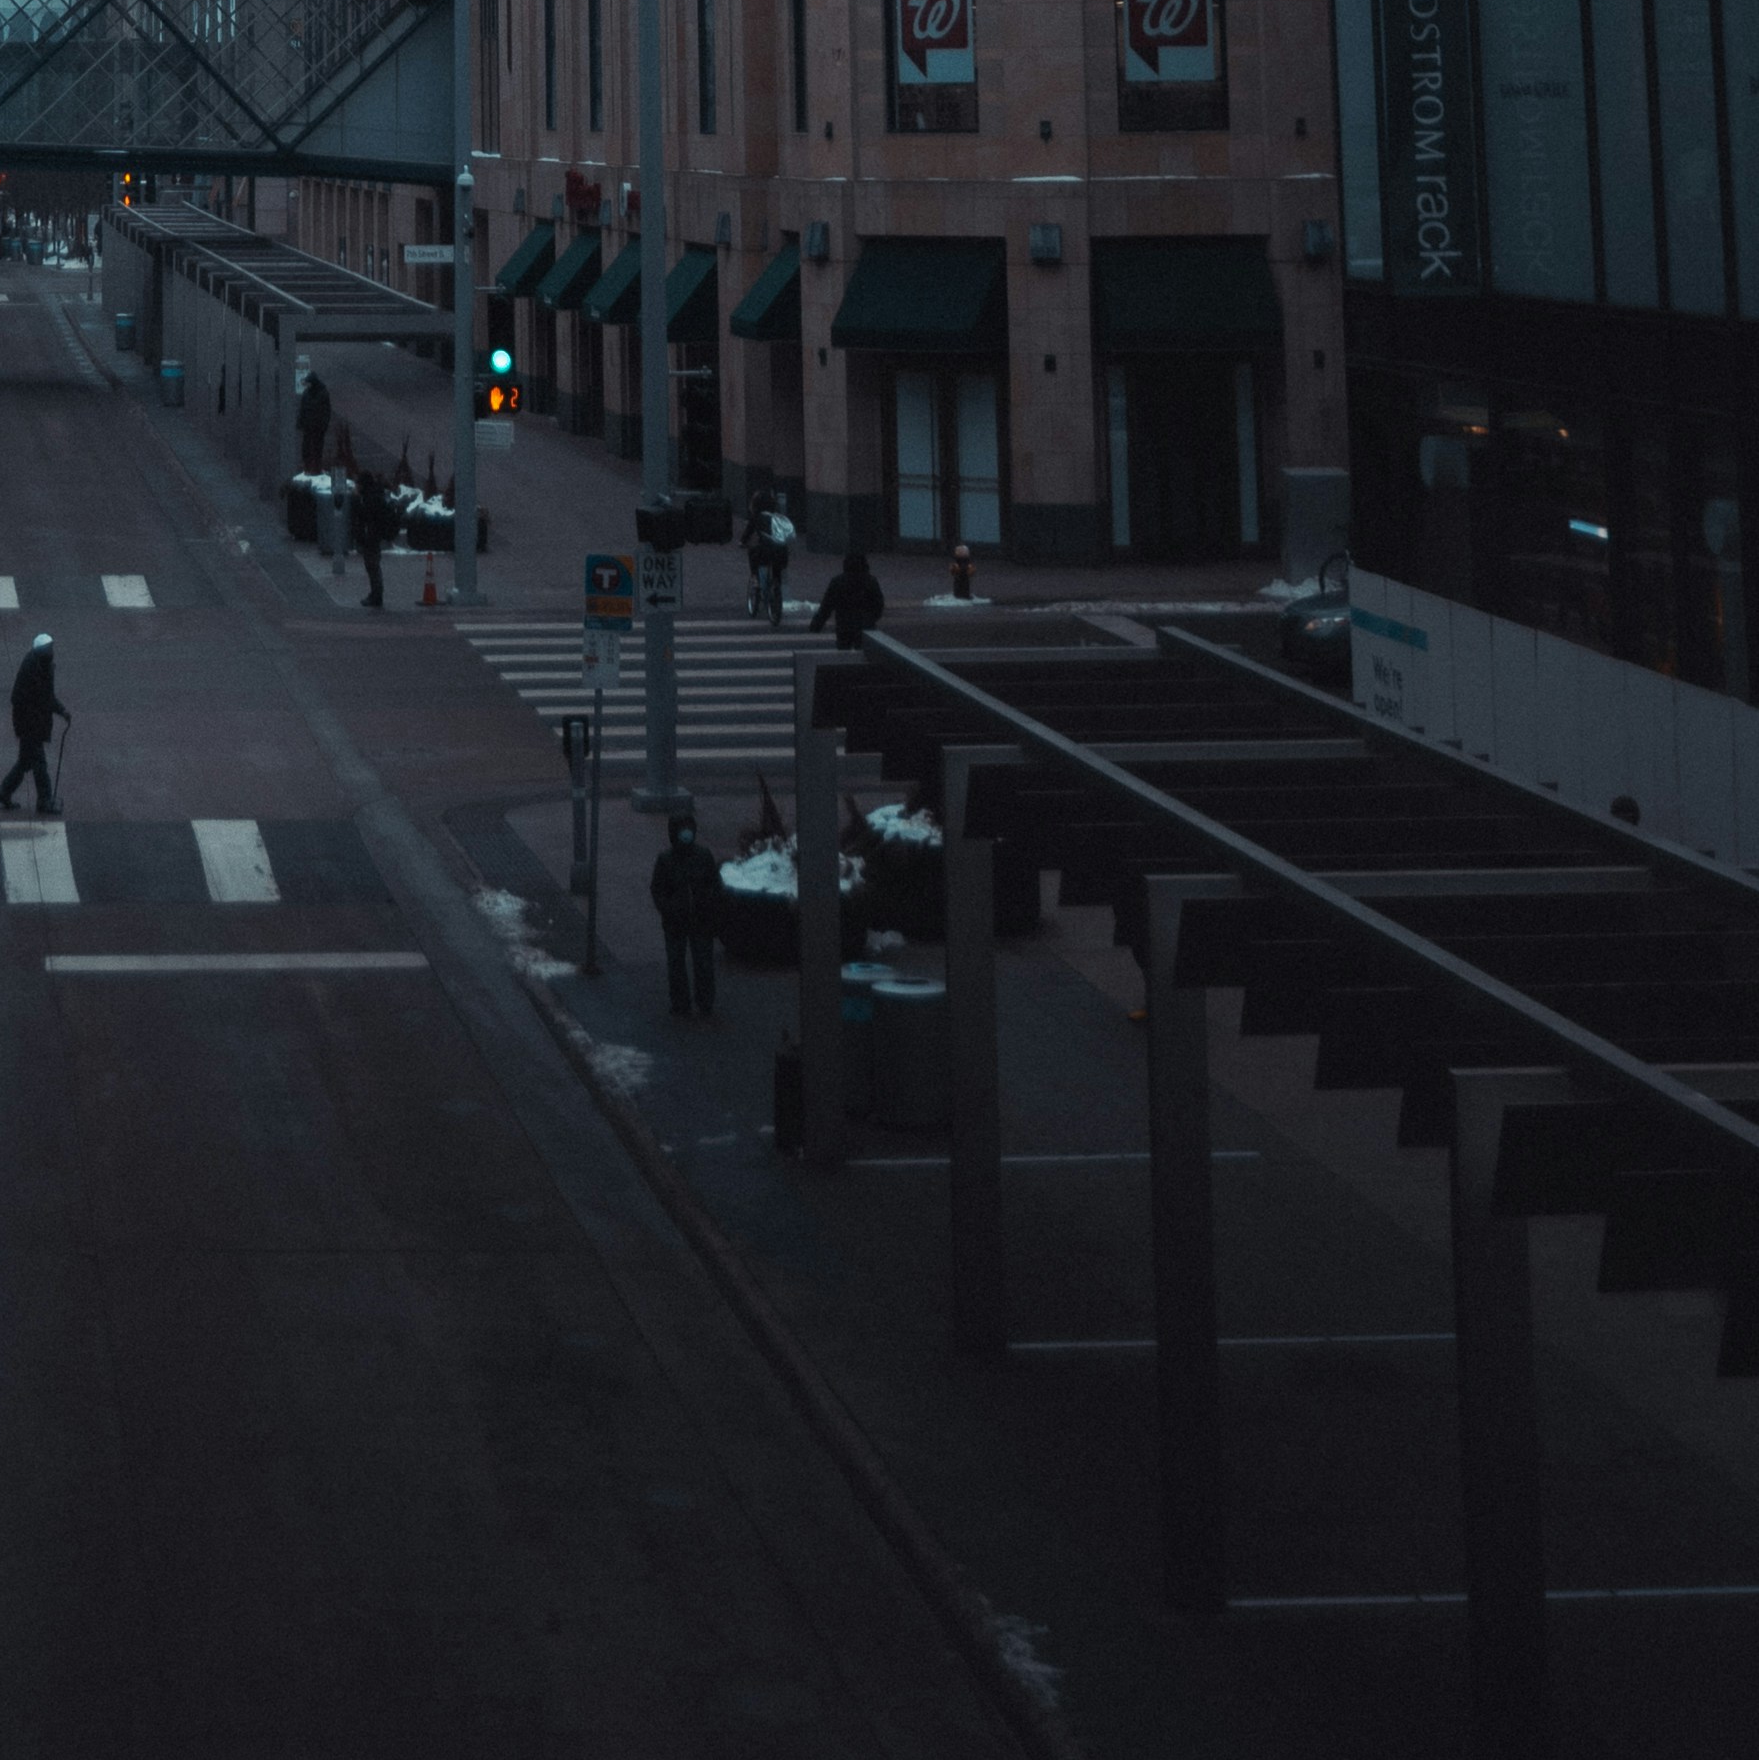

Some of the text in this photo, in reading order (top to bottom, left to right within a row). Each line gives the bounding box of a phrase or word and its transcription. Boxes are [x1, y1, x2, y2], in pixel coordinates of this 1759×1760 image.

[1416, 173, 1463, 280] rack
[509, 385, 520, 410] 2
[643, 556, 677, 571] ONE
[642, 574, 678, 589] WAY
